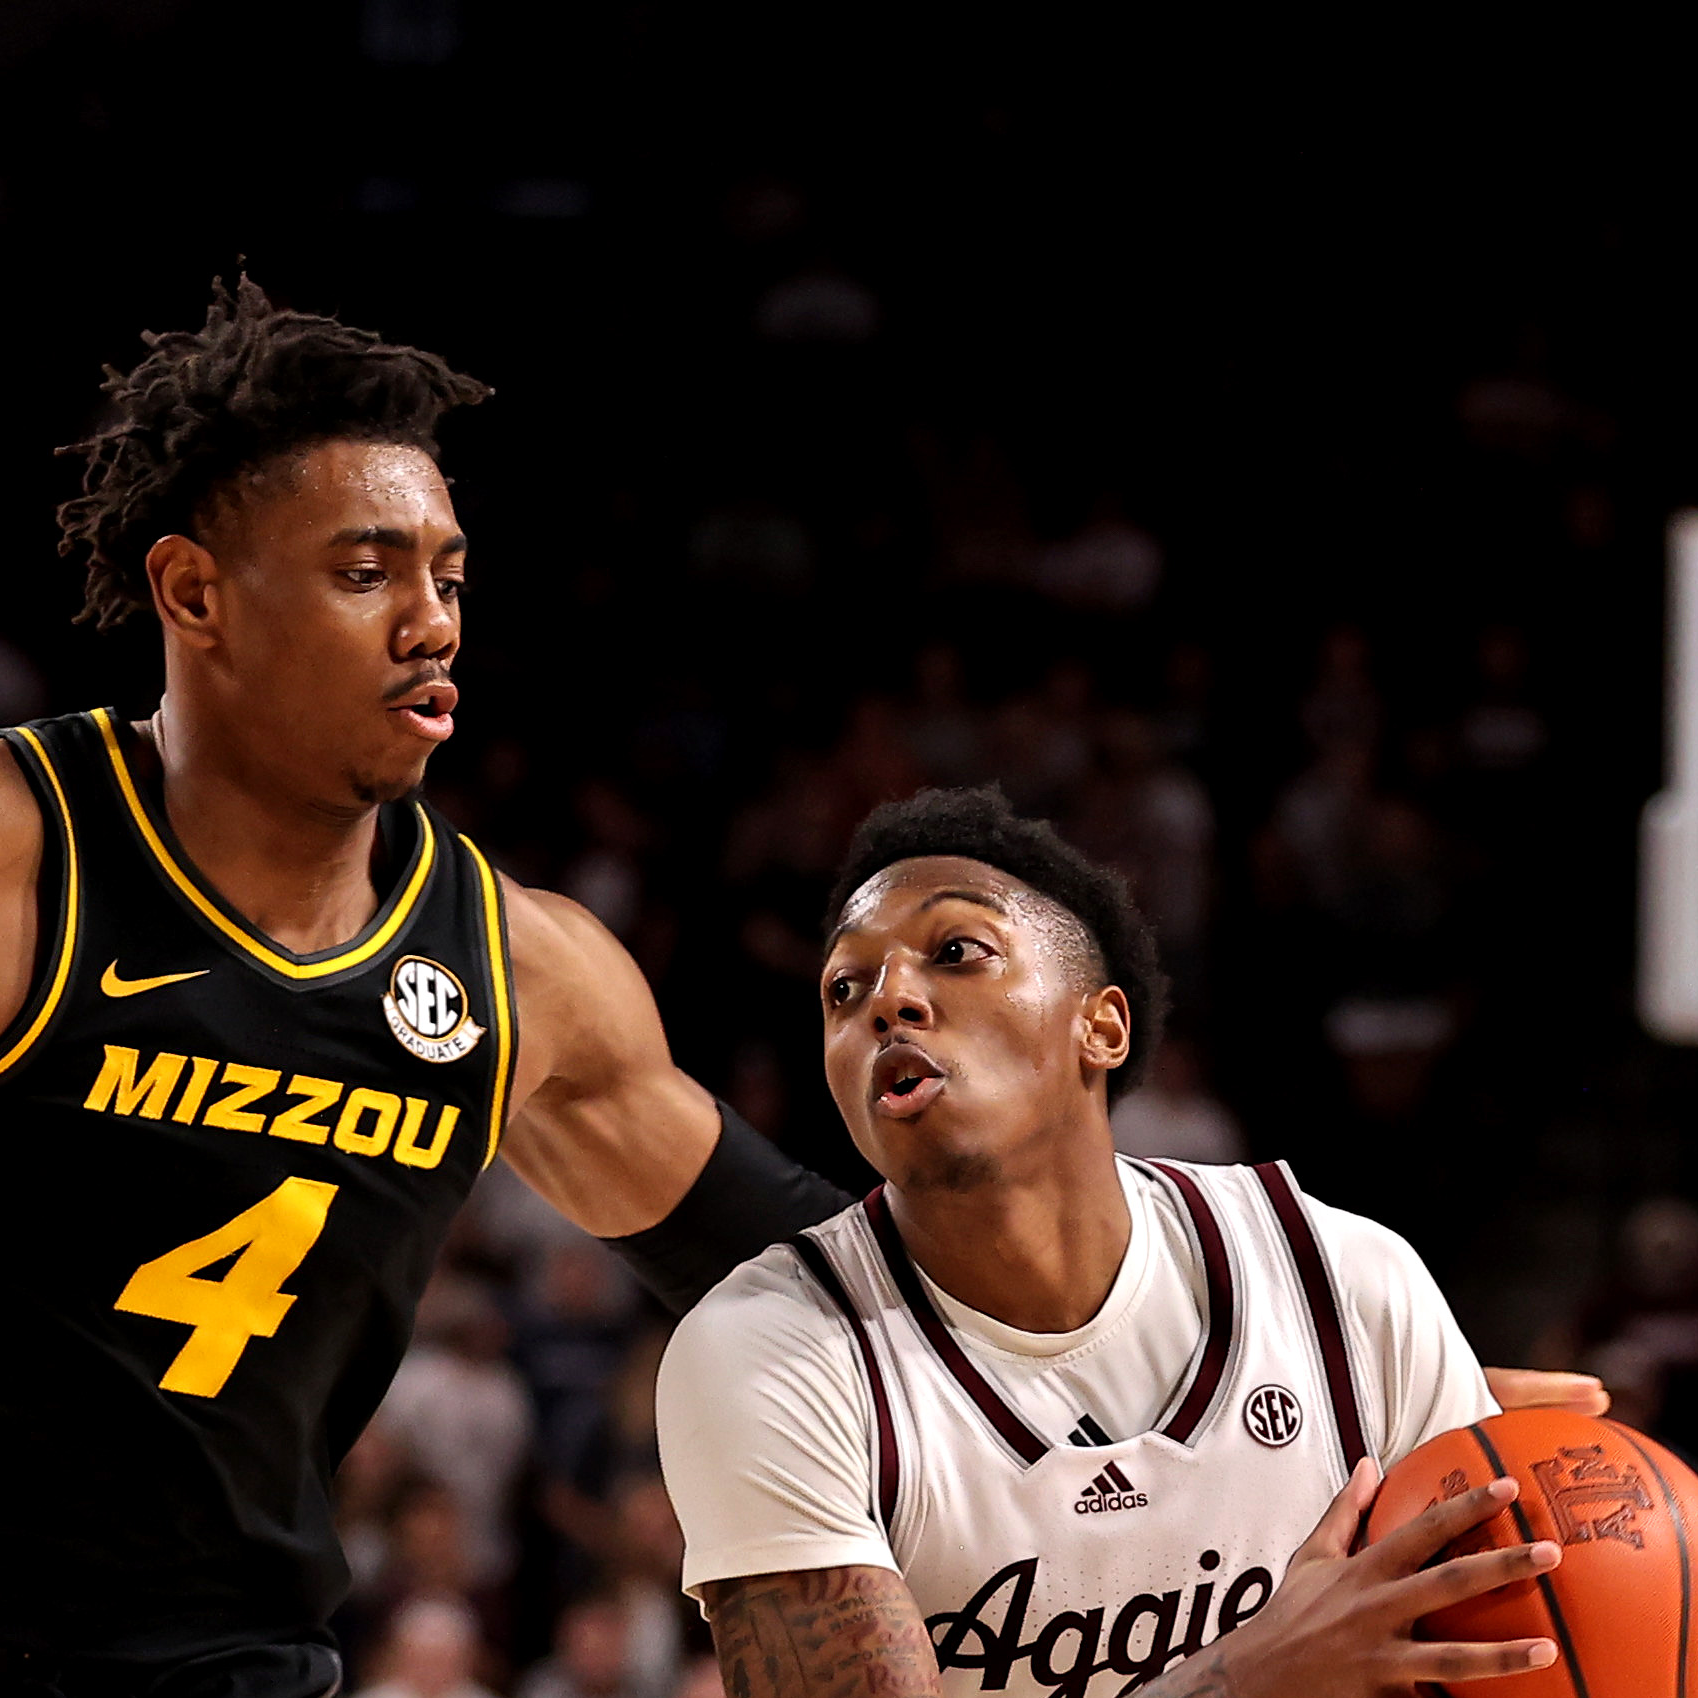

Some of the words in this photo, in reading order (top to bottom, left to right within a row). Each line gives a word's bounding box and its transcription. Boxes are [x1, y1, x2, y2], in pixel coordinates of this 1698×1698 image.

[396, 961, 459, 1036] SEC
[390, 1015, 467, 1060] GRADUATE
[83, 1043, 462, 1170] MIZZOU
[114, 1176, 339, 1399] 4
[1249, 1389, 1298, 1441] SEC
[1073, 1492, 1149, 1515] adidas
